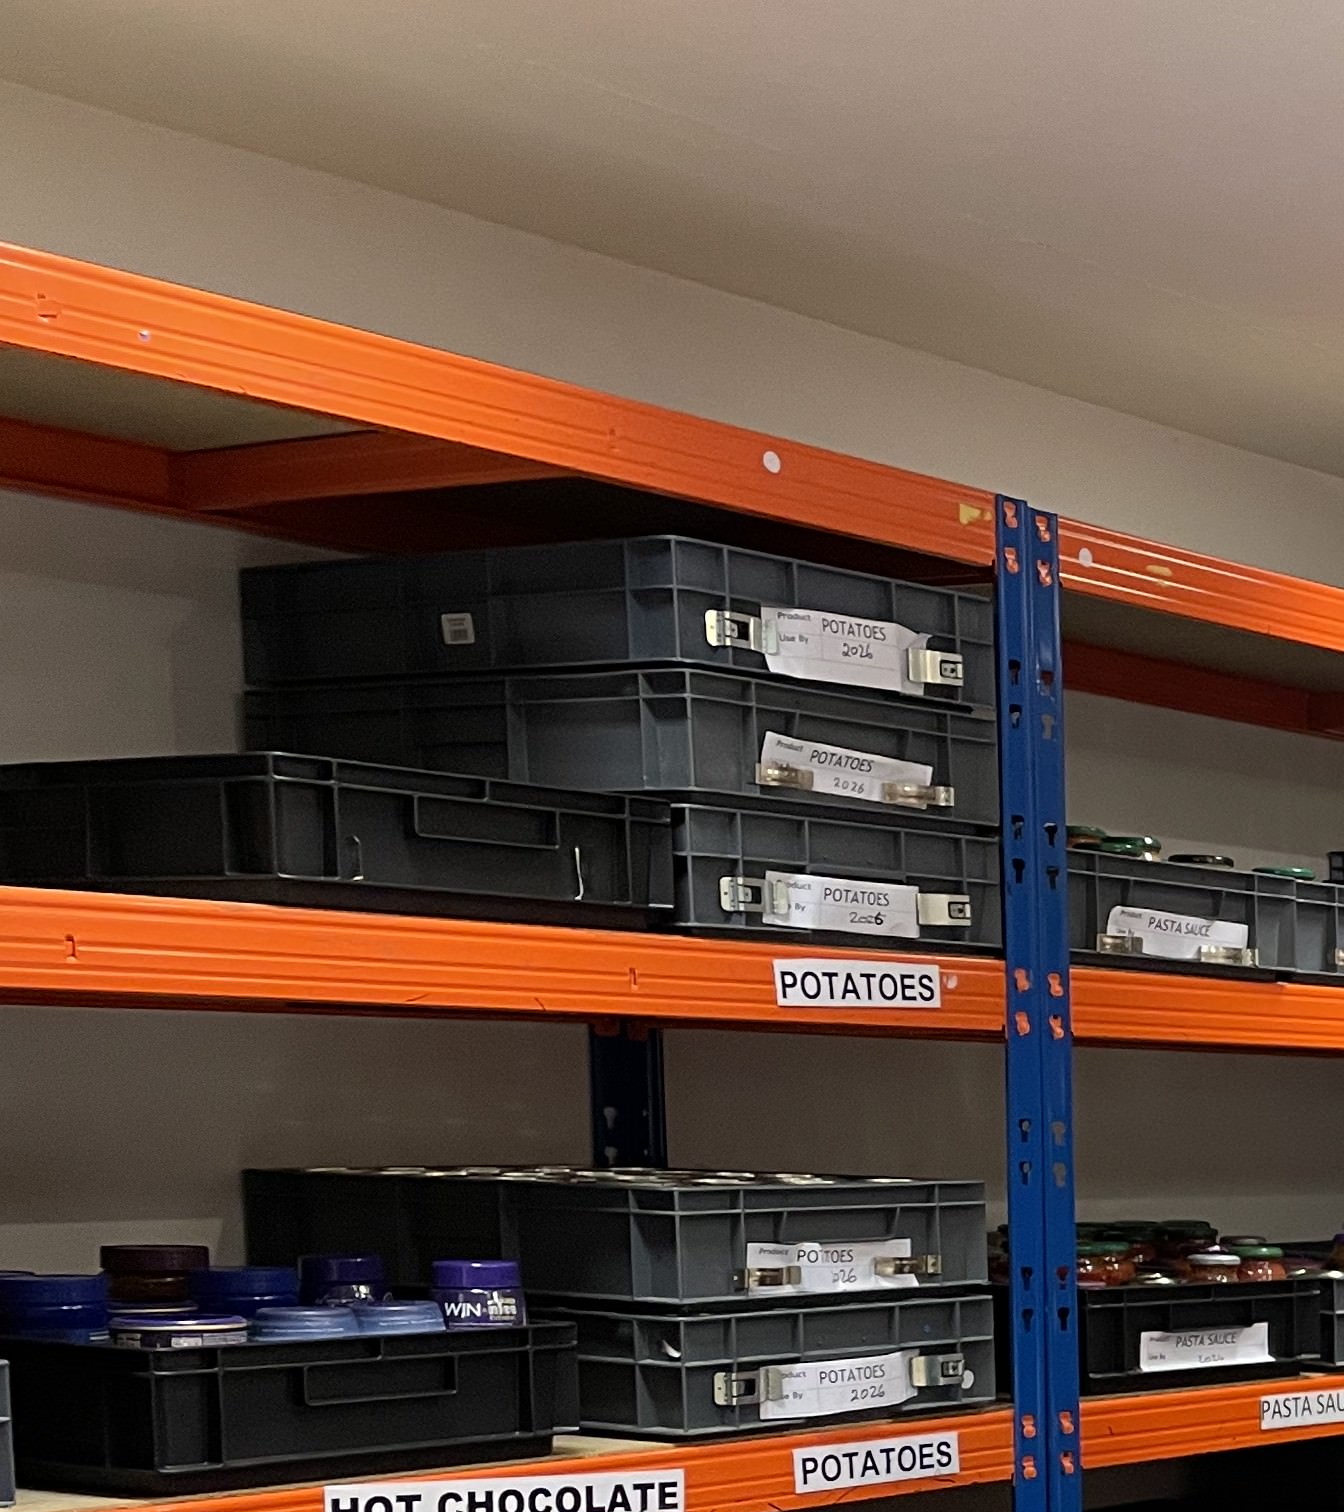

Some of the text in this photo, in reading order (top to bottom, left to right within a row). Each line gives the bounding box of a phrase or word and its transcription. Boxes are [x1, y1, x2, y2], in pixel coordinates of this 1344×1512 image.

[822, 617, 886, 641] POTATOES
[842, 642, 873, 660] 2026
[810, 750, 875, 773] POTATOES
[833, 777, 865, 795] 2026
[823, 887, 890, 907] POTATOES
[1148, 916, 1211, 938] PASTA SAUCE
[779, 970, 935, 1002] POTATOES
[444, 1301, 482, 1319] WIN
[1175, 1331, 1237, 1348] PASTA SAUCE
[819, 1363, 886, 1385] POTATOES
[850, 1384, 886, 1402] 2026
[1261, 1396, 1313, 1421] PASTA
[801, 1440, 953, 1486] POTATOES
